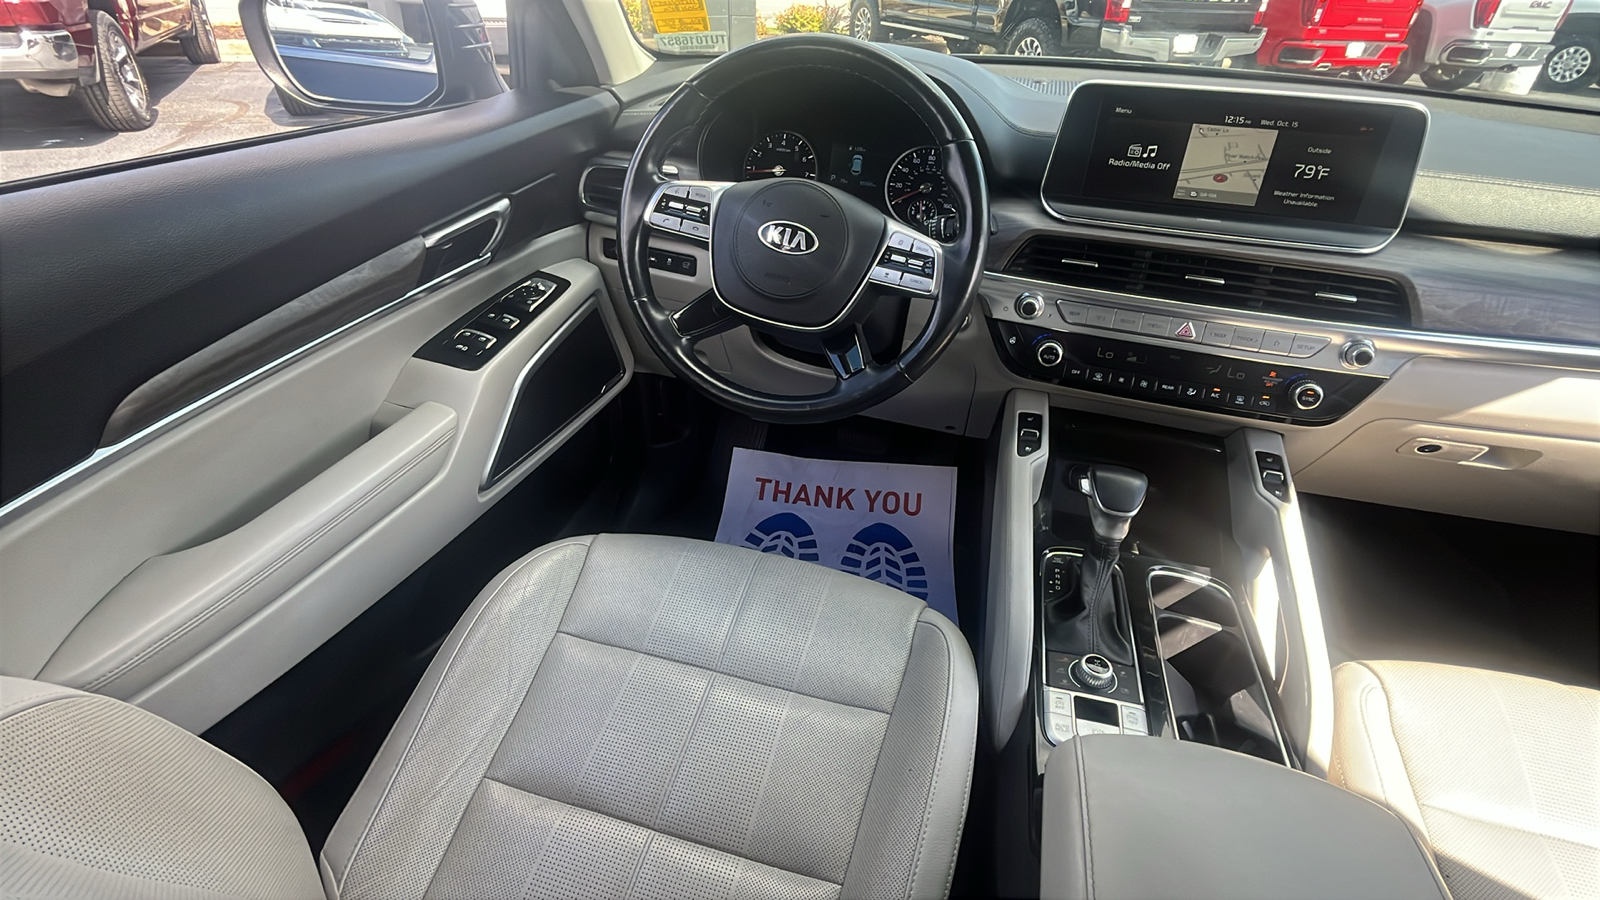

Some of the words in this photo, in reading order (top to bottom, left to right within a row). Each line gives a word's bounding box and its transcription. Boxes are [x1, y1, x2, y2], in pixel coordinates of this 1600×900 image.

[1224, 115, 1245, 124] 12:15
[1307, 146, 1332, 154] Outside
[1108, 158, 1156, 169] Radio/Media
[1156, 162, 1171, 170] Off
[1294, 163, 1330, 179] 79°F
[1299, 192, 1335, 200] Information
[767, 224, 807, 251] KIA
[755, 477, 856, 511] THANK
[864, 489, 923, 517] YOU
